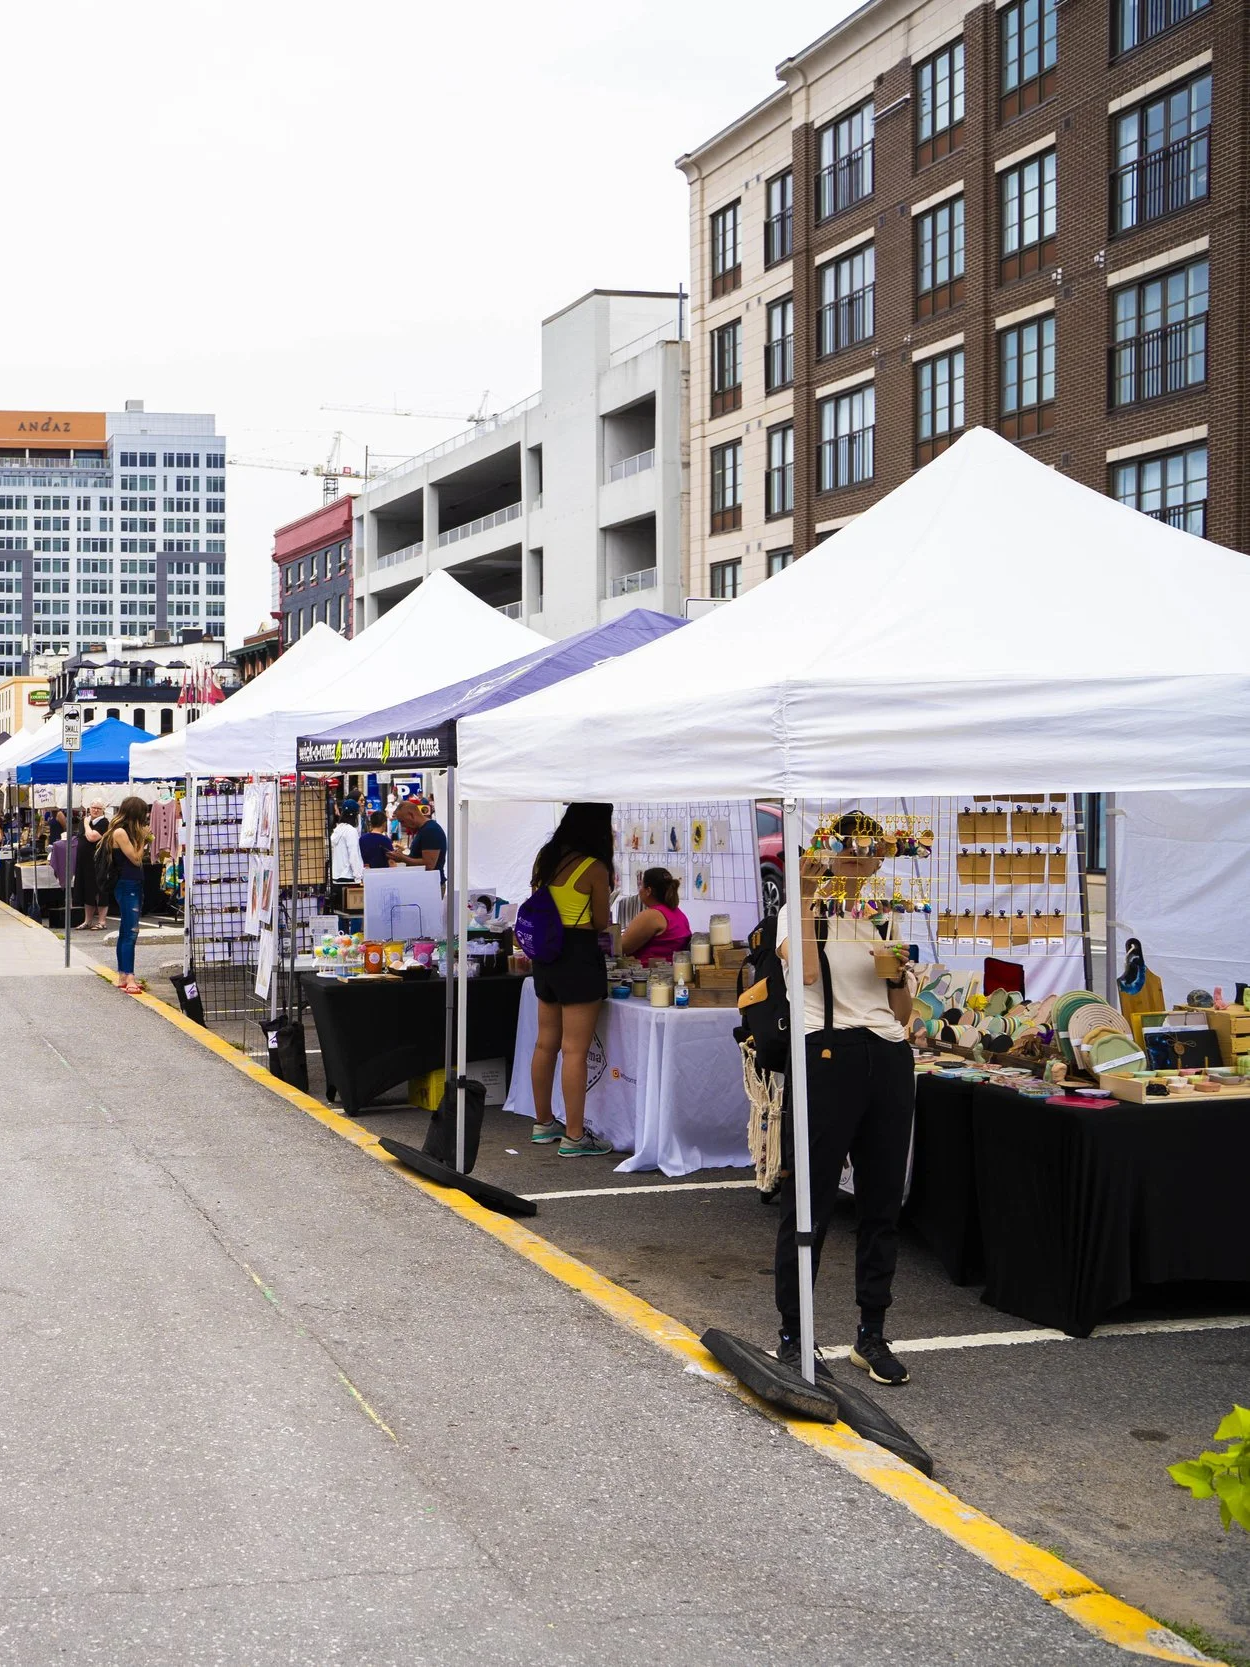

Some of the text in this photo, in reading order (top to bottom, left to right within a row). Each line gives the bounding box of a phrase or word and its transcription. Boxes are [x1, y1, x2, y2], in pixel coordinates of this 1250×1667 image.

[65, 725, 78, 733] SMALL
[299, 733, 440, 762] wick-o-roma wick-o-roma wick-o-roma
